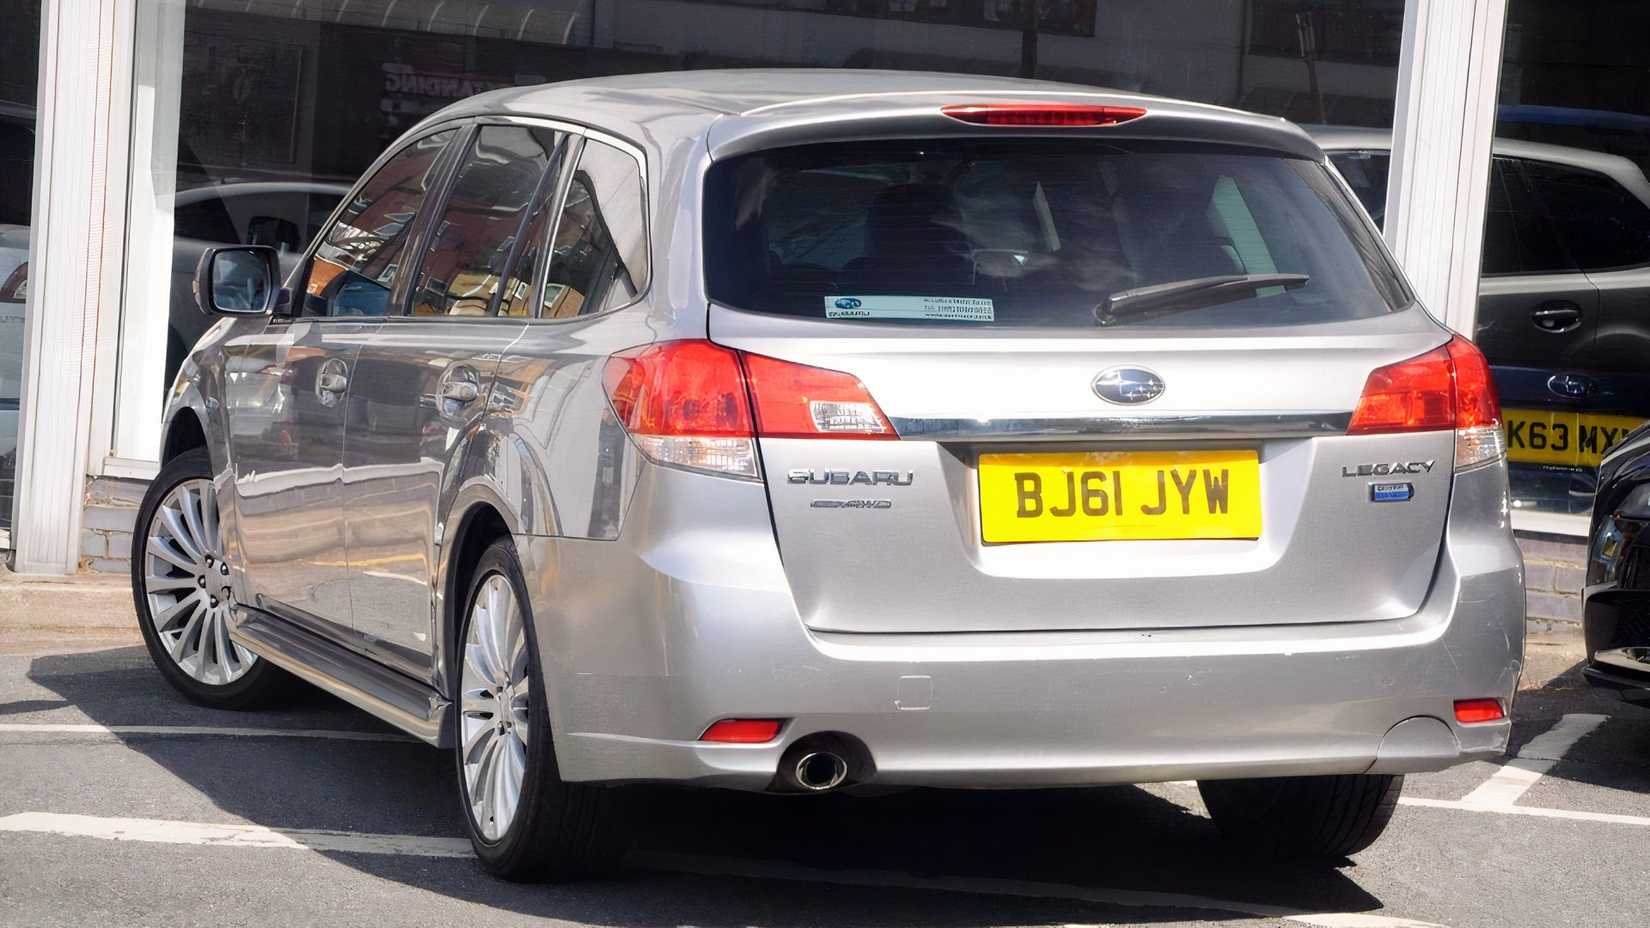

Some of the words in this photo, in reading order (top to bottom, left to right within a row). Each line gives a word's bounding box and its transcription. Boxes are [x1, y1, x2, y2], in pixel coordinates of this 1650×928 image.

[1507, 420, 1568, 451] K63
[787, 468, 913, 486] SUBARU
[1342, 460, 1436, 477] LEGACY
[1014, 471, 1123, 518] BJ61
[1140, 469, 1229, 516] JYW
